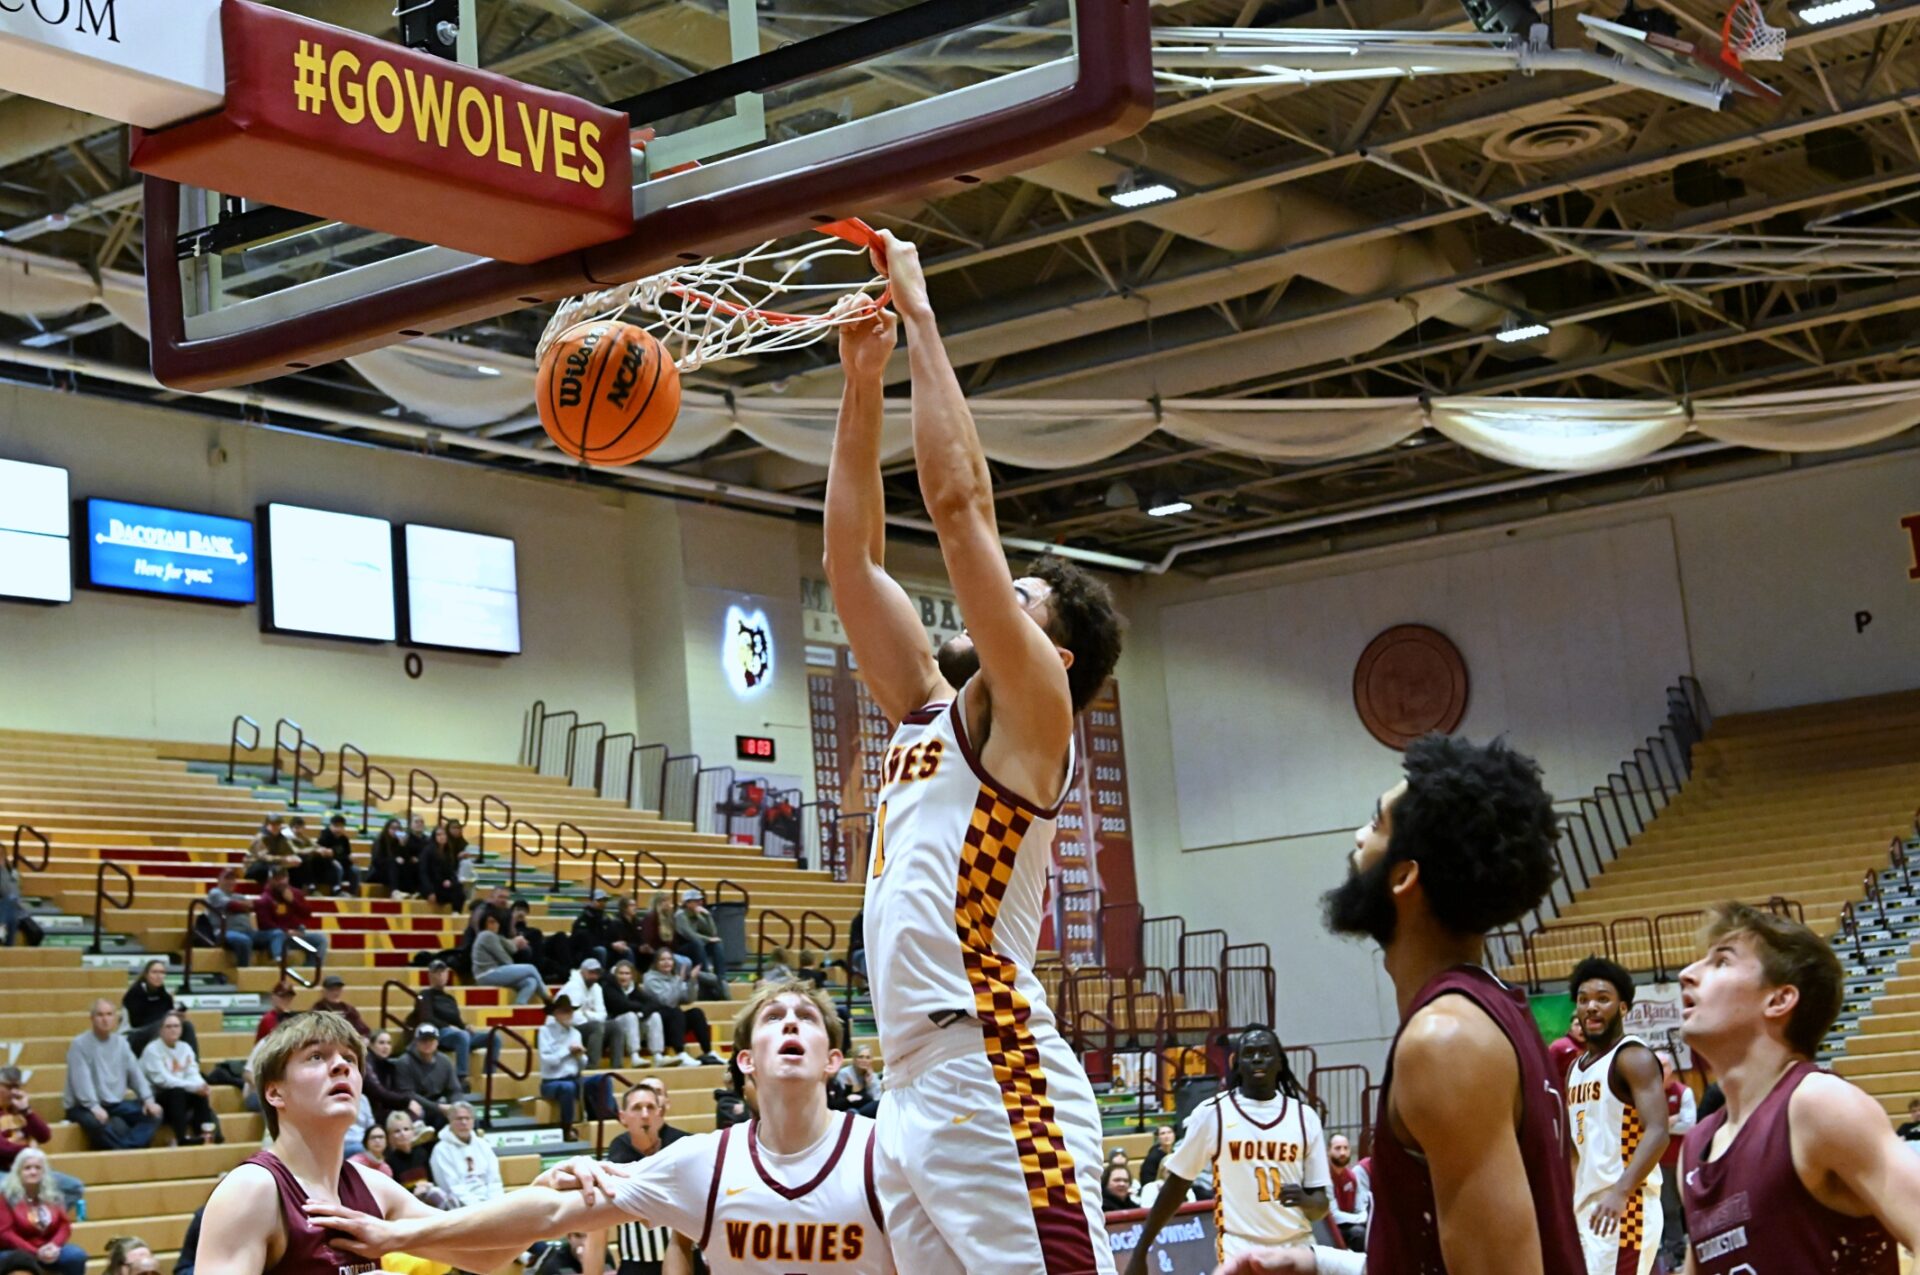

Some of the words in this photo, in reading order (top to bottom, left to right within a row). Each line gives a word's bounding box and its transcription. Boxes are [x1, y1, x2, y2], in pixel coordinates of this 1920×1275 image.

[293, 39, 605, 188] #GOWOLVES
[606, 341, 645, 411] NCAA
[1855, 611, 1872, 634] P
[1228, 1140, 1298, 1163] WOLVES
[724, 1220, 864, 1262] WOLVES
